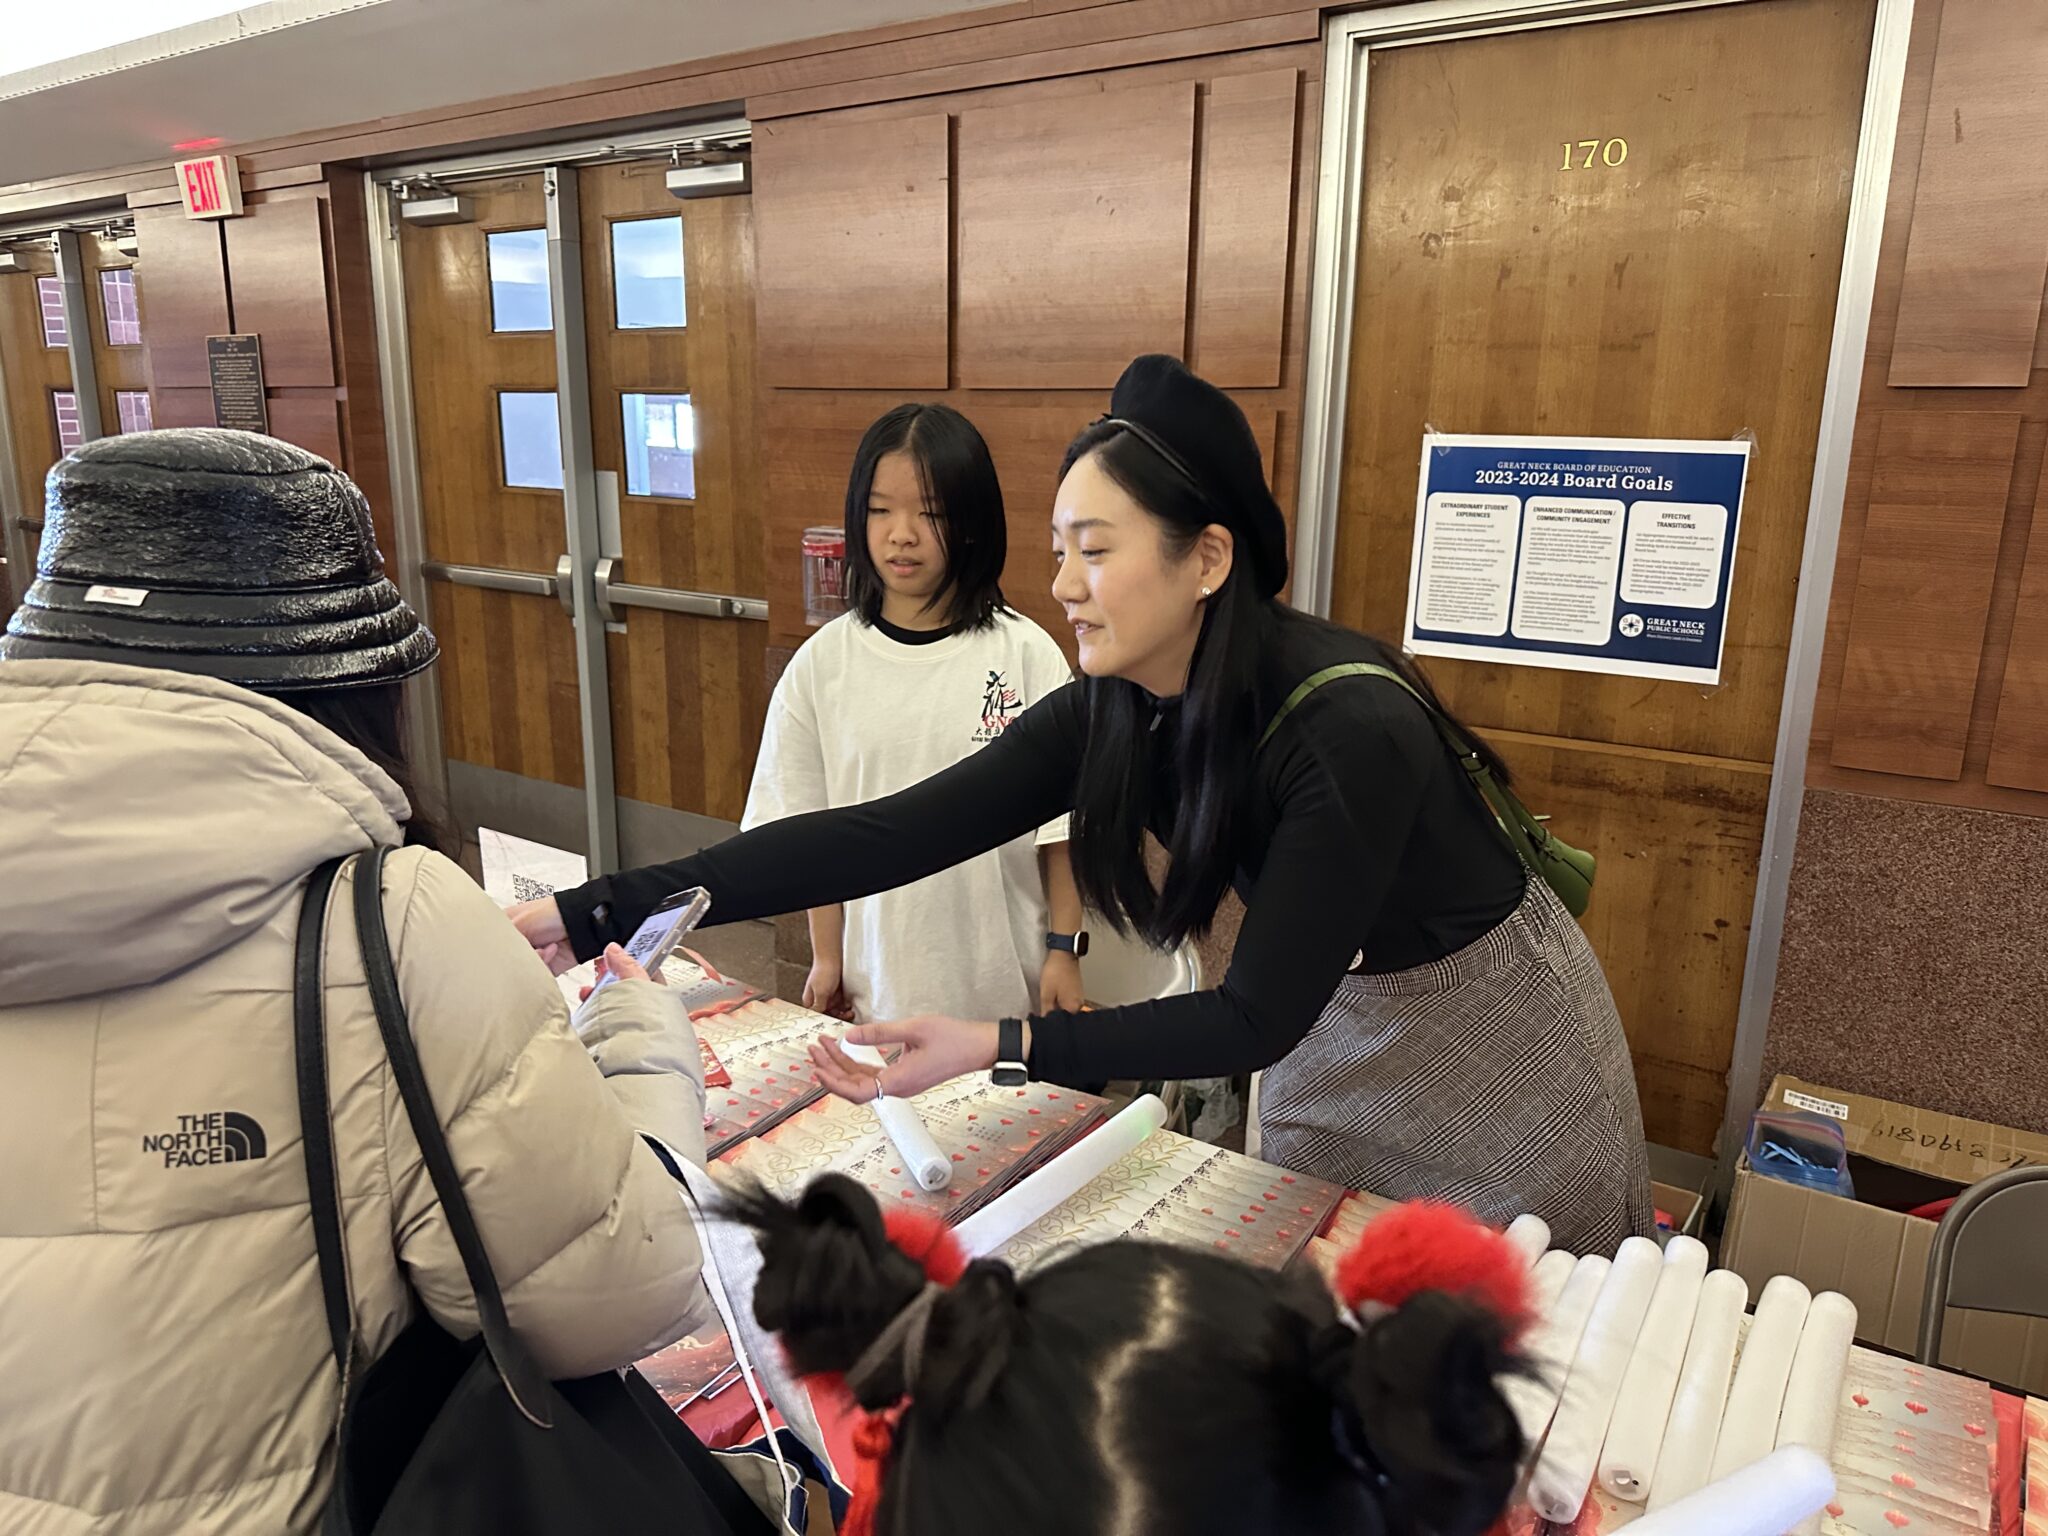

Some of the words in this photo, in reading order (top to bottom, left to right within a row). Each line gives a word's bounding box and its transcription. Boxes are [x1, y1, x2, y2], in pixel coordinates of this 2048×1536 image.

[1559, 137, 1629, 171] 170
[184, 160, 221, 212] EXIT
[1497, 461, 1526, 470] GREAT
[1527, 462, 1552, 470] NECK
[1553, 462, 1584, 472] BOARD
[1584, 464, 1596, 472] OF
[1597, 464, 1652, 474] EDUCATION
[1475, 470, 1560, 486] 2023-2024
[1562, 472, 1617, 489] Board
[1621, 474, 1674, 491] Goals
[1440, 502, 1483, 510] EXTRAORDINARY
[1484, 503, 1509, 511] STUDENT
[1533, 506, 1563, 514] ENHANCED
[1563, 507, 1613, 516] COMMUNICATION
[1455, 511, 1491, 519] EXPERIENCES
[1536, 514, 1571, 522] COMMUNITY
[1571, 516, 1611, 524] ENGAGEMENT
[1661, 512, 1692, 521] EFFECTIVE
[1656, 521, 1697, 530] TRANSITIONS
[1646, 617, 1678, 628] GREAT
[1678, 620, 1706, 630] NECK
[1646, 625, 1671, 633] PUBLIC
[1671, 626, 1705, 636] SCHOOLS
[177, 1112, 222, 1132] THE
[142, 1130, 223, 1153] NORTH
[164, 1147, 223, 1169] FACE
